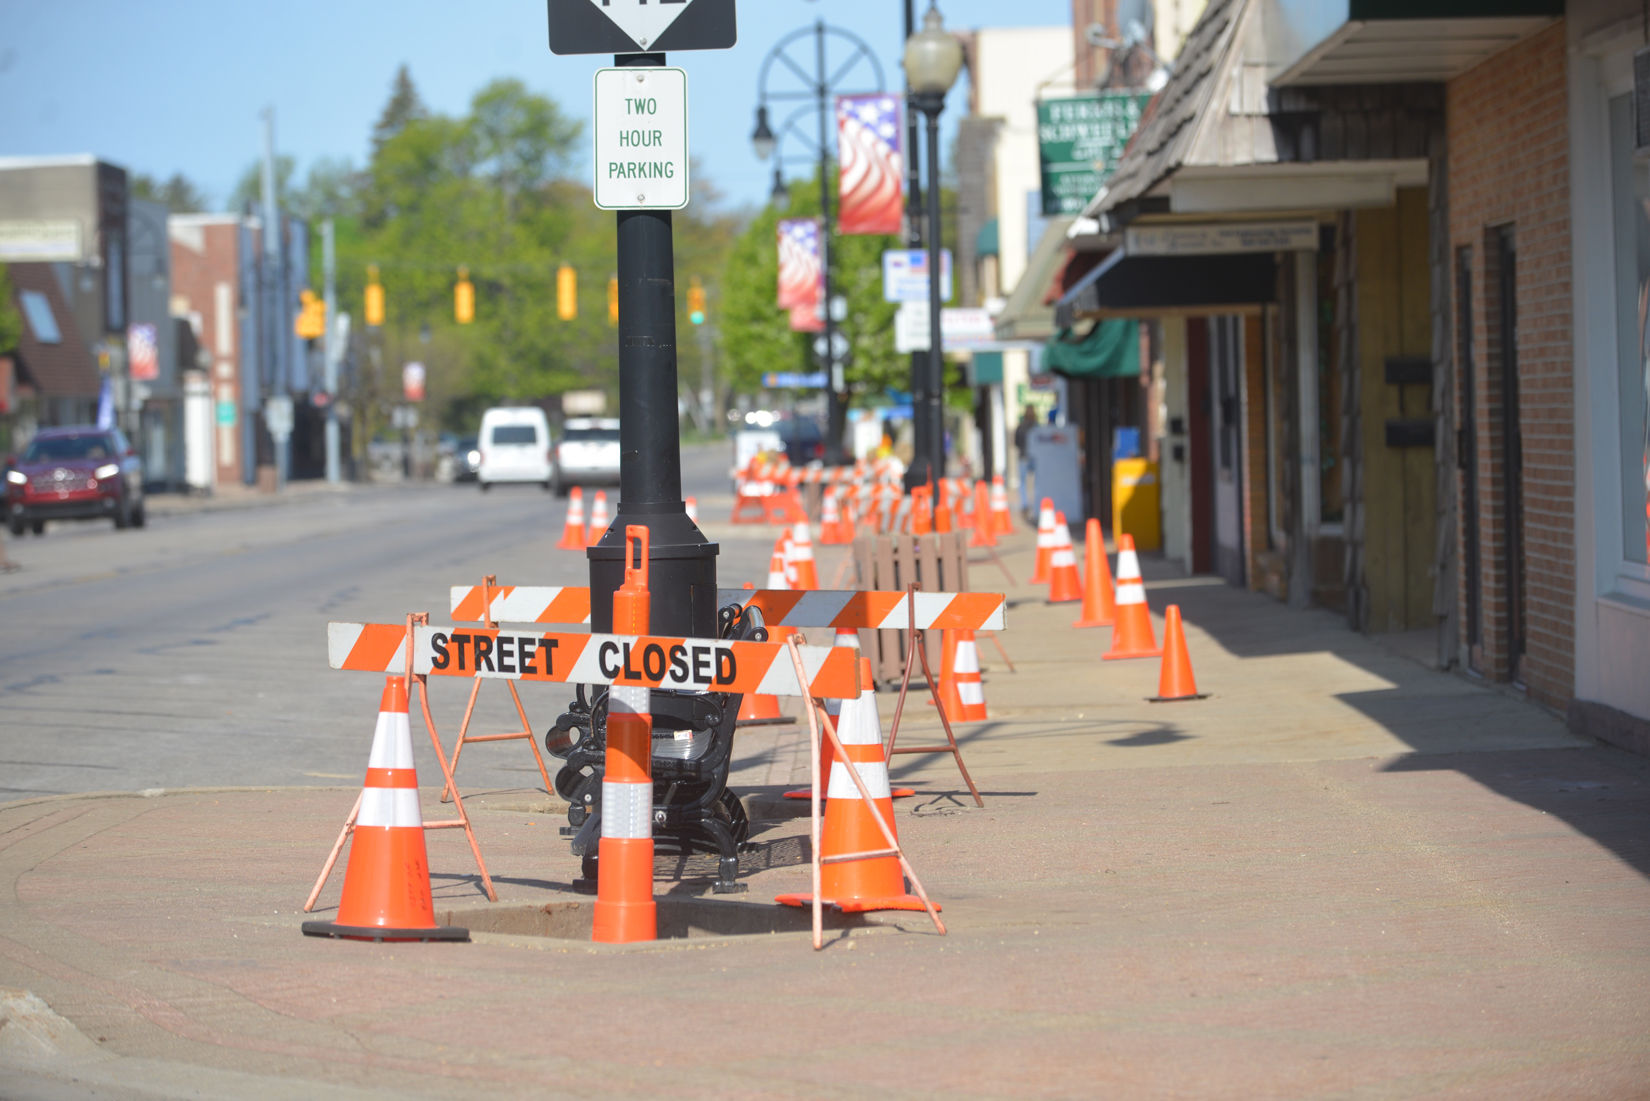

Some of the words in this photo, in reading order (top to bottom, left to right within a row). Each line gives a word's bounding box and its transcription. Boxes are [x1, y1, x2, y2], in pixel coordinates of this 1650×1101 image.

[625, 98, 657, 115] TWO
[619, 130, 662, 147] HOUR
[608, 161, 674, 179] PARKING
[431, 632, 559, 675] STREET
[598, 641, 738, 685] CLOSED
